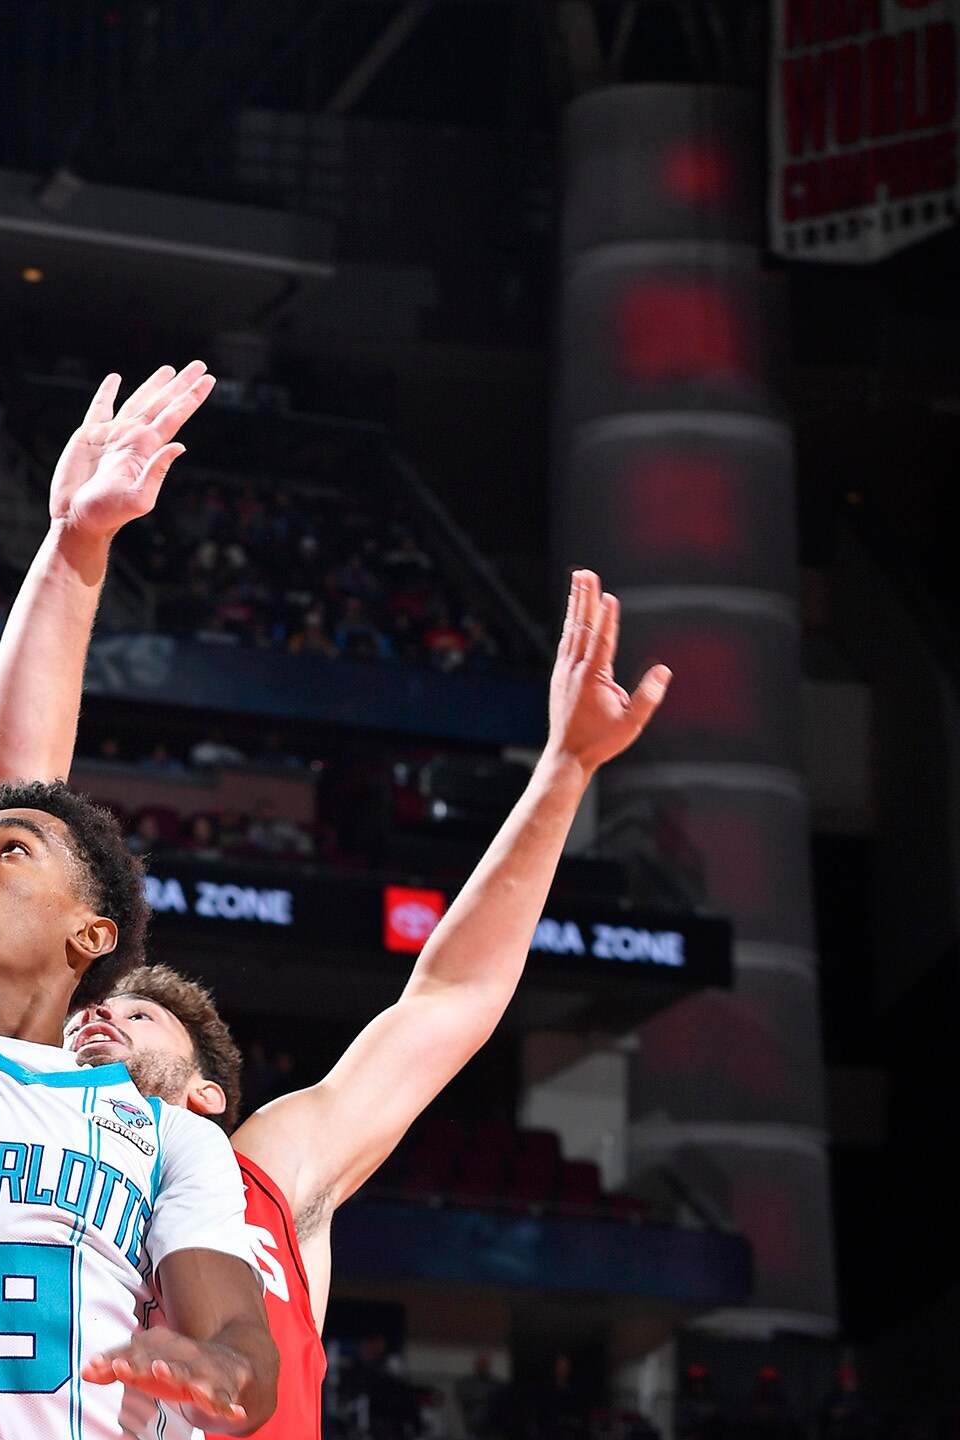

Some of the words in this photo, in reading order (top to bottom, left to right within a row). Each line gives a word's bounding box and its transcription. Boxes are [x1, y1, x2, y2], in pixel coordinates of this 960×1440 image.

[195, 880, 293, 925] ZONE
[591, 922, 685, 967] ZONE
[92, 1115, 155, 1156] FEASTABLES
